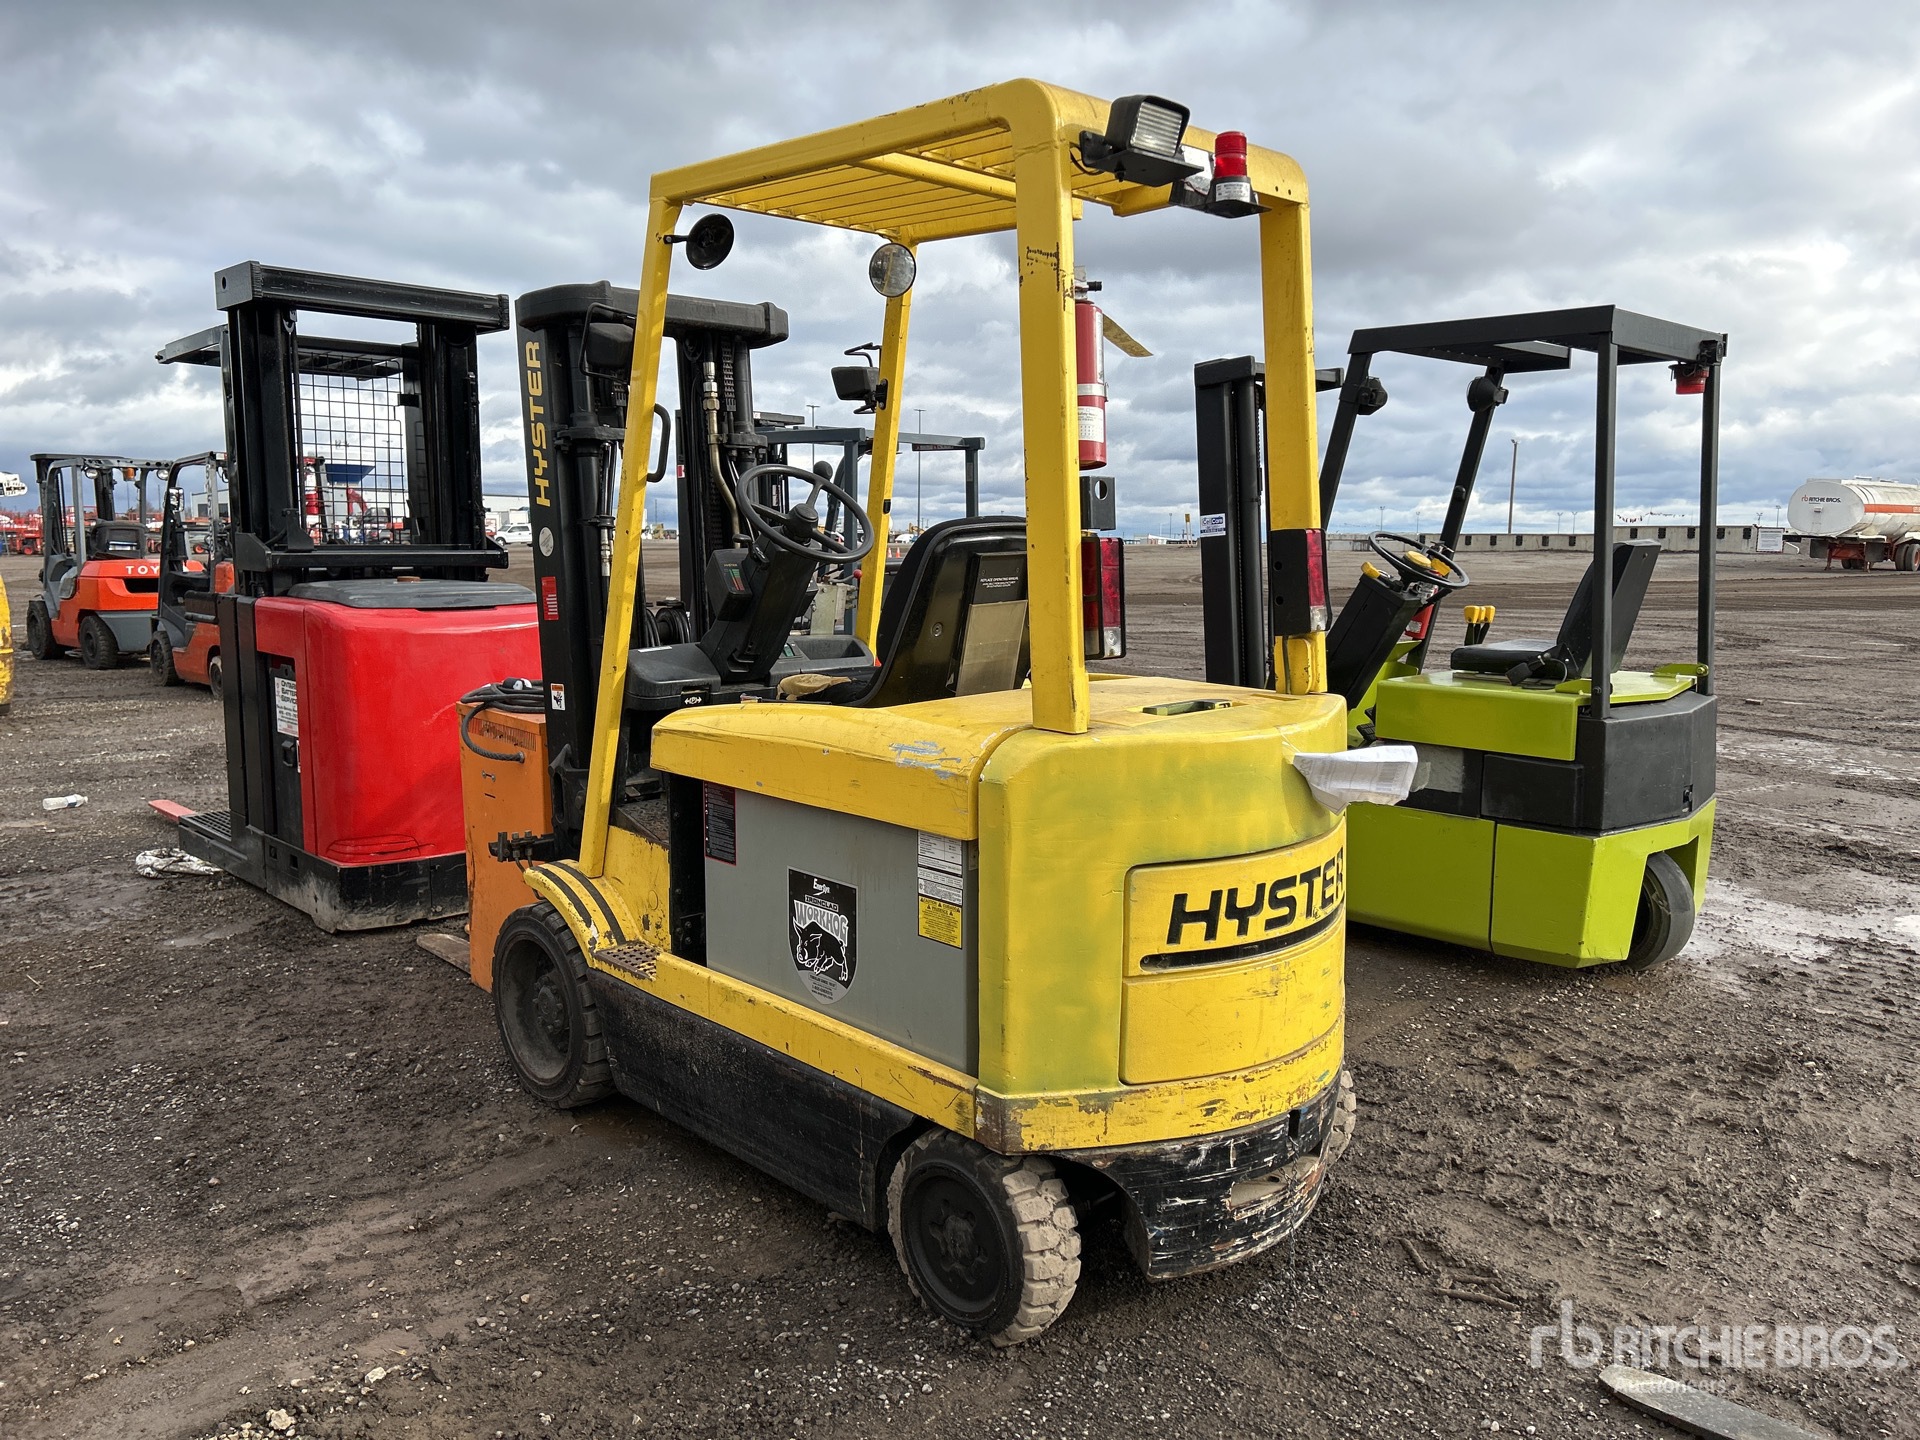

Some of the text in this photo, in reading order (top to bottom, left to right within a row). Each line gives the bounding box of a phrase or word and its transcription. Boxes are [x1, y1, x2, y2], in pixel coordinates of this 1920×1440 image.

[525, 341, 551, 507] HYSTER
[125, 565, 160, 575] TOY
[806, 896, 838, 911] IRONCLAD
[1166, 846, 1345, 945] HYSTER
[794, 900, 848, 946] WORKHOG
